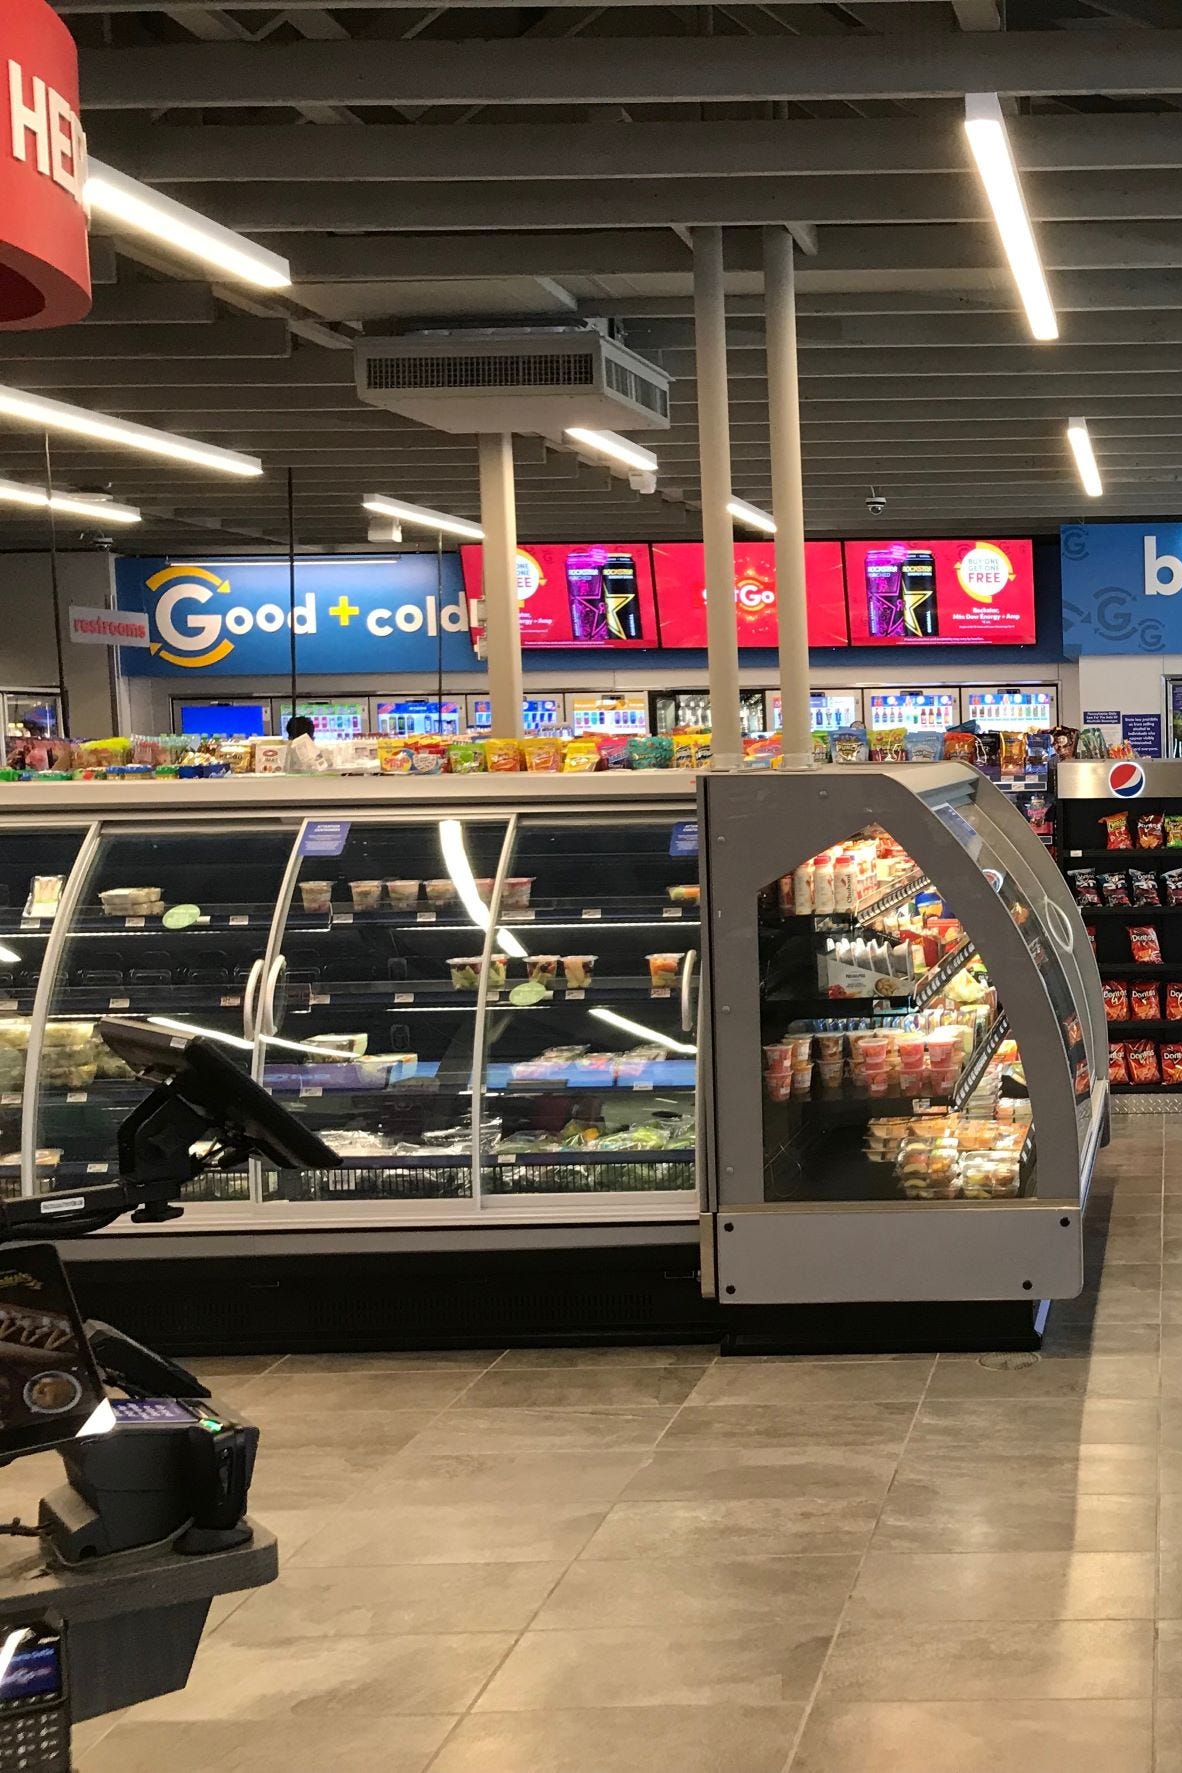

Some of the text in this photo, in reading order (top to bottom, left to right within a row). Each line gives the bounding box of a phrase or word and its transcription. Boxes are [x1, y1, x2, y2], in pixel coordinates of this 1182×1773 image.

[968, 573, 1000, 583] FREE
[73, 616, 147, 638] restrooms
[155, 584, 470, 651] Good + cold
